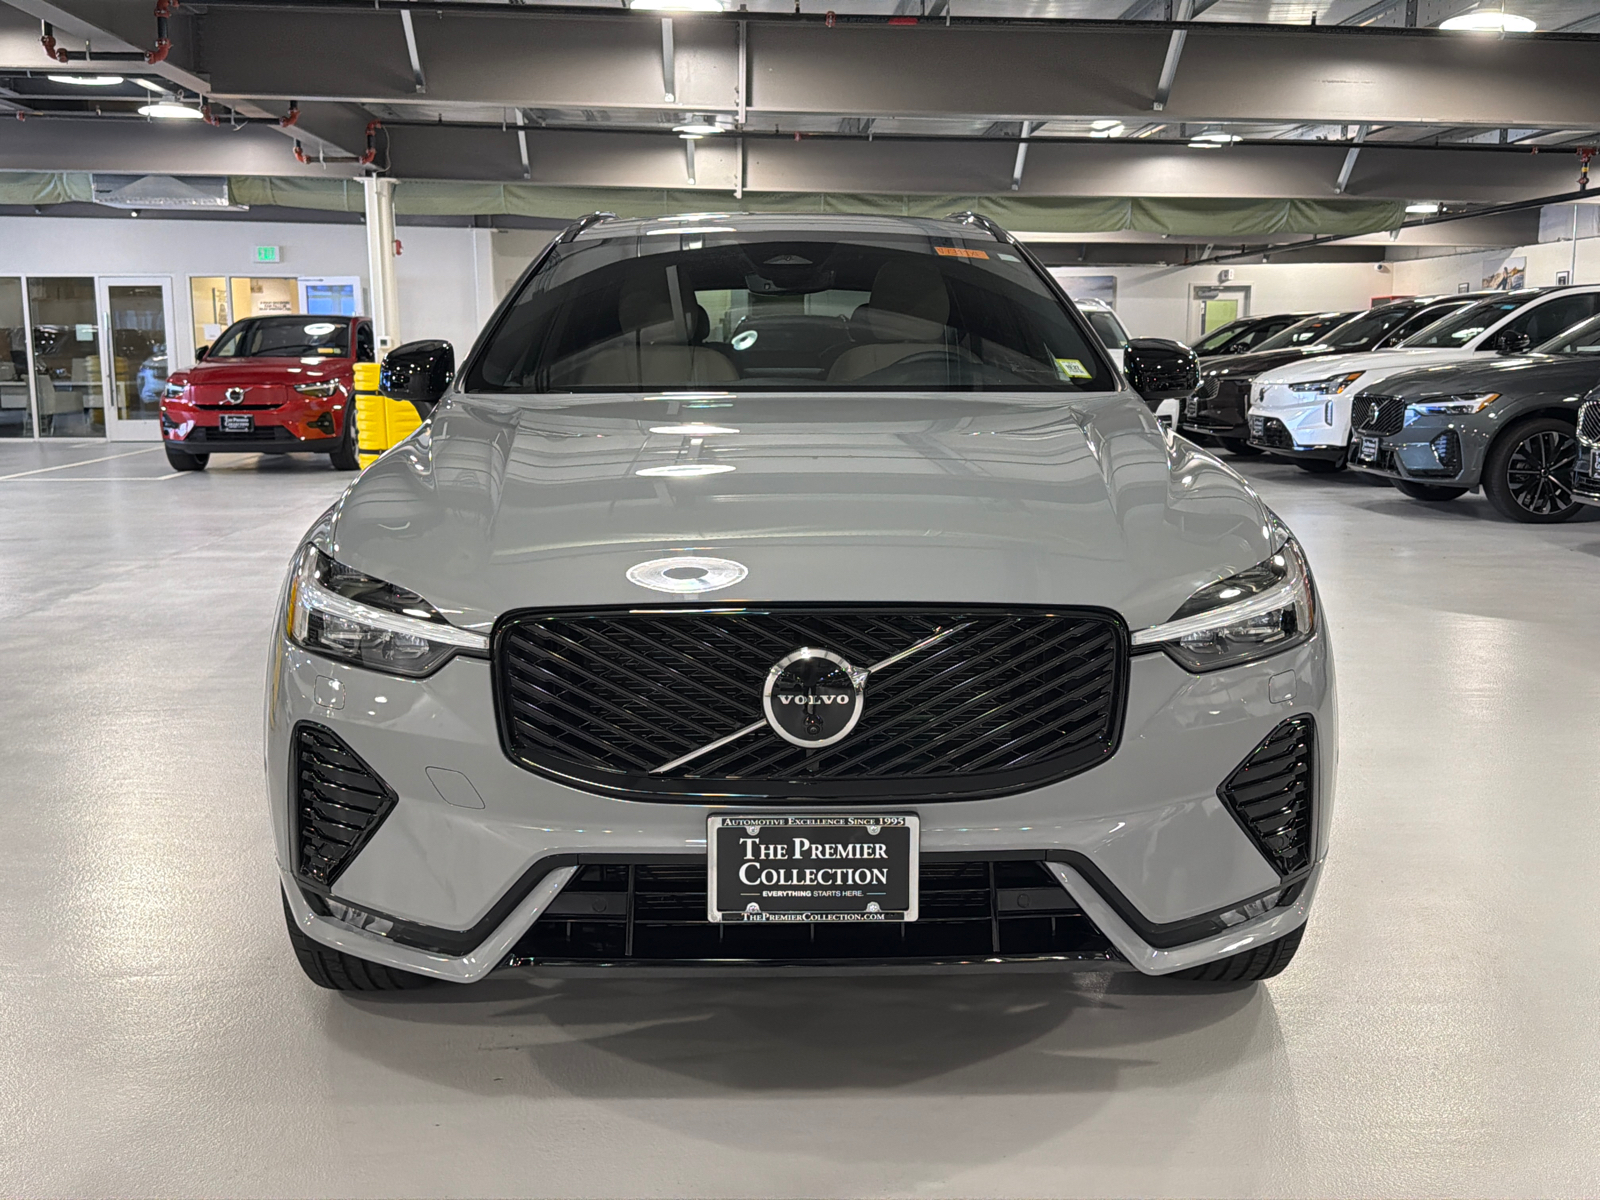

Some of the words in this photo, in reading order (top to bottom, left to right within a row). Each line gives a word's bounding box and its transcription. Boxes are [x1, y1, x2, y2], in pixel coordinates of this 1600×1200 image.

[777, 694, 849, 705] VOLVO
[724, 818, 786, 826] AUTOMOTIVE
[788, 817, 846, 826] EXCELLENCE
[847, 816, 876, 826] SINCE
[879, 816, 904, 825] 1995
[739, 837, 789, 860] THE
[791, 837, 889, 859] PREMIER
[738, 861, 889, 886] COLLECTION
